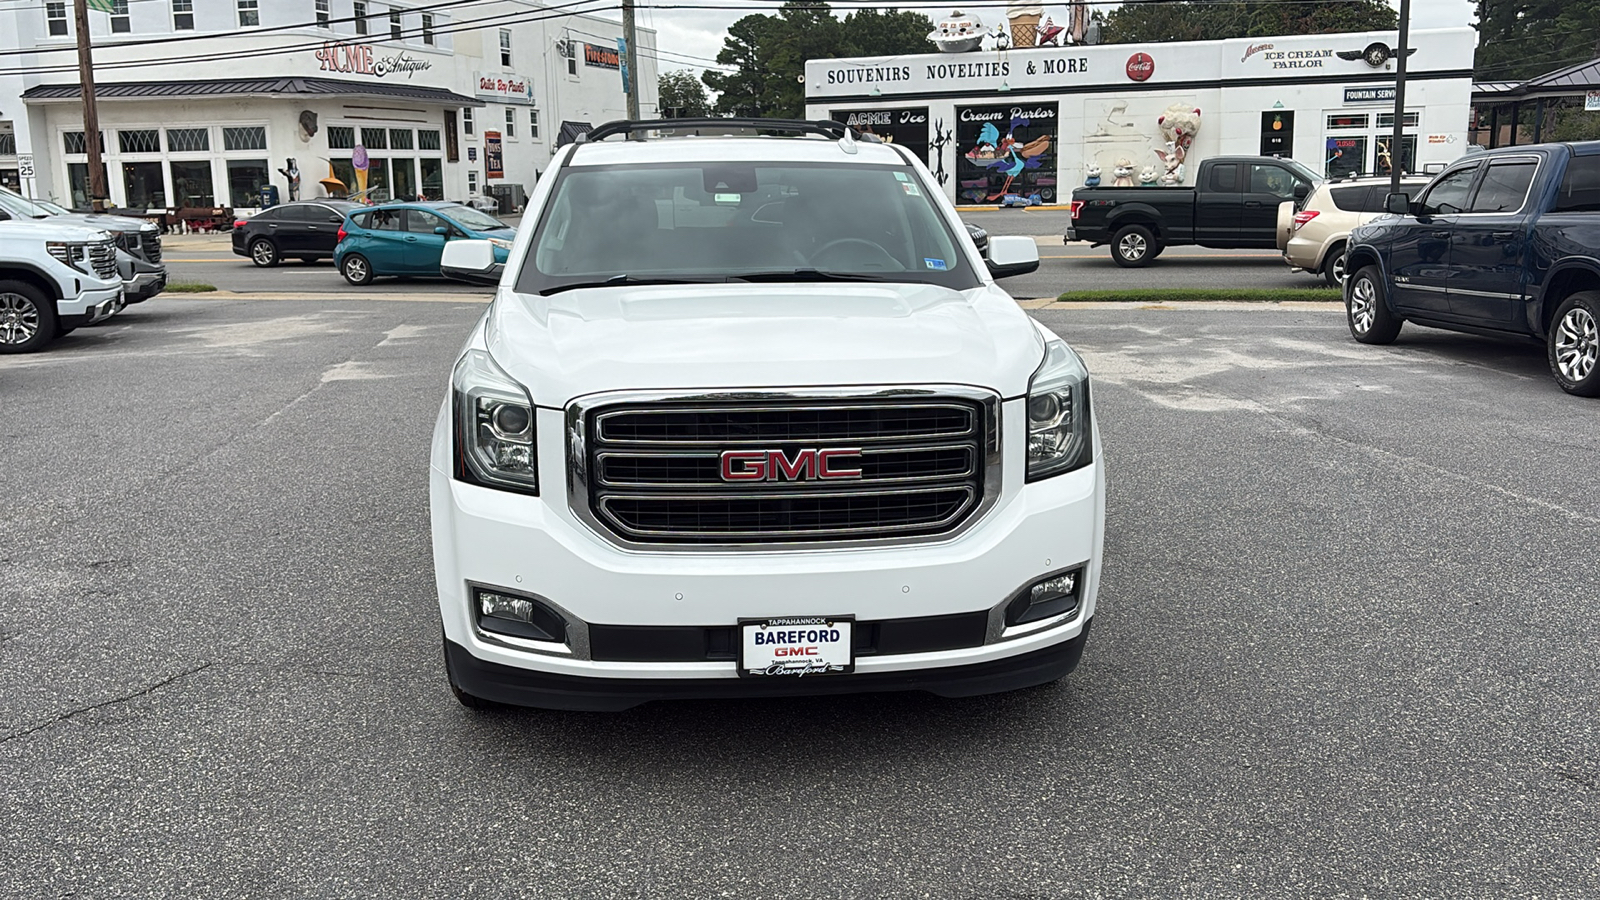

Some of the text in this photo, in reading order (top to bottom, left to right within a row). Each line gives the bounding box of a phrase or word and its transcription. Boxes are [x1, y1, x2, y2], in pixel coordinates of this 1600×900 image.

[315, 40, 374, 75] ACME
[386, 51, 432, 79] Antiques
[1264, 49, 1333, 60] ICE CREAM
[827, 58, 1088, 84] SOUVENIRS NOVELTIES & MORE
[1272, 60, 1323, 69] PARLOR
[497, 79, 507, 94] Boy
[1346, 89, 1377, 99] FOUNTAIN
[847, 111, 926, 125] ACME Ice
[960, 107, 1055, 121] Cream Parlor
[20, 166, 34, 176] 25
[720, 448, 863, 482] GMC
[768, 618, 827, 626] TAPPAHANNOCK
[754, 629, 840, 645] BAREFORD
[774, 646, 820, 657] GMC
[765, 662, 830, 678] Bareford
